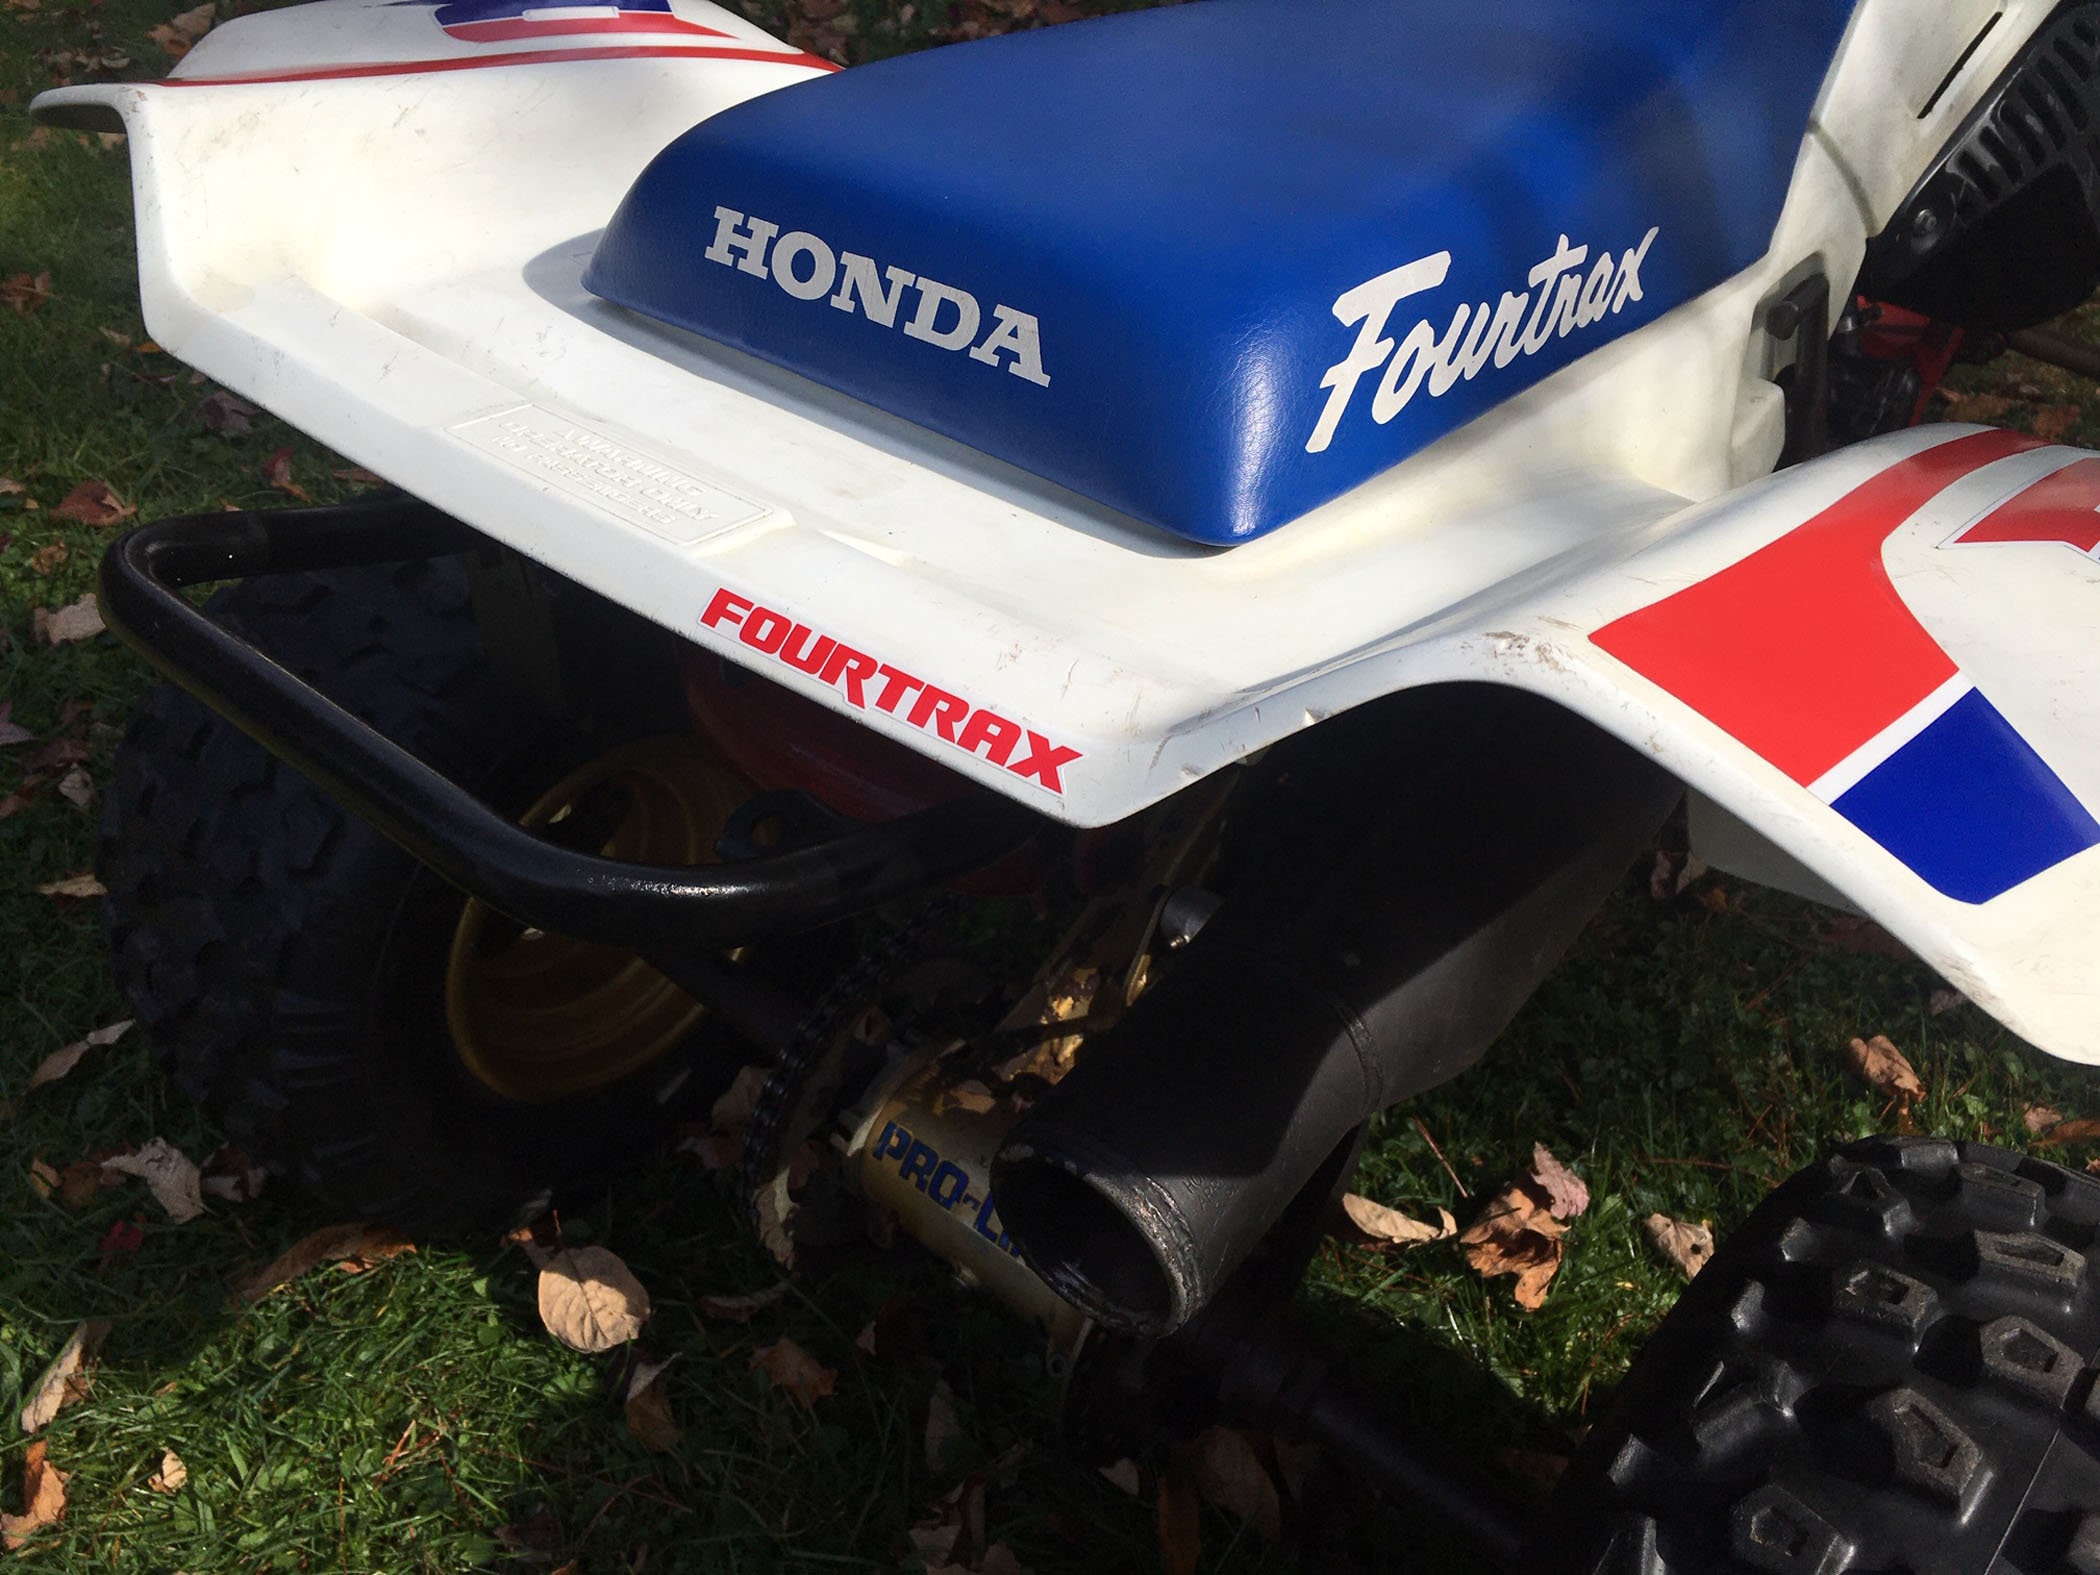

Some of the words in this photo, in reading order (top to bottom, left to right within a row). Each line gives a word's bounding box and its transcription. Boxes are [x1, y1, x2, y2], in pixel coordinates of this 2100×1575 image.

[704, 205, 1051, 388] HONDA
[1305, 226, 1660, 453] Fourtrax
[636, 485, 721, 522] ONLY
[700, 588, 1083, 794] FOURTRAX
